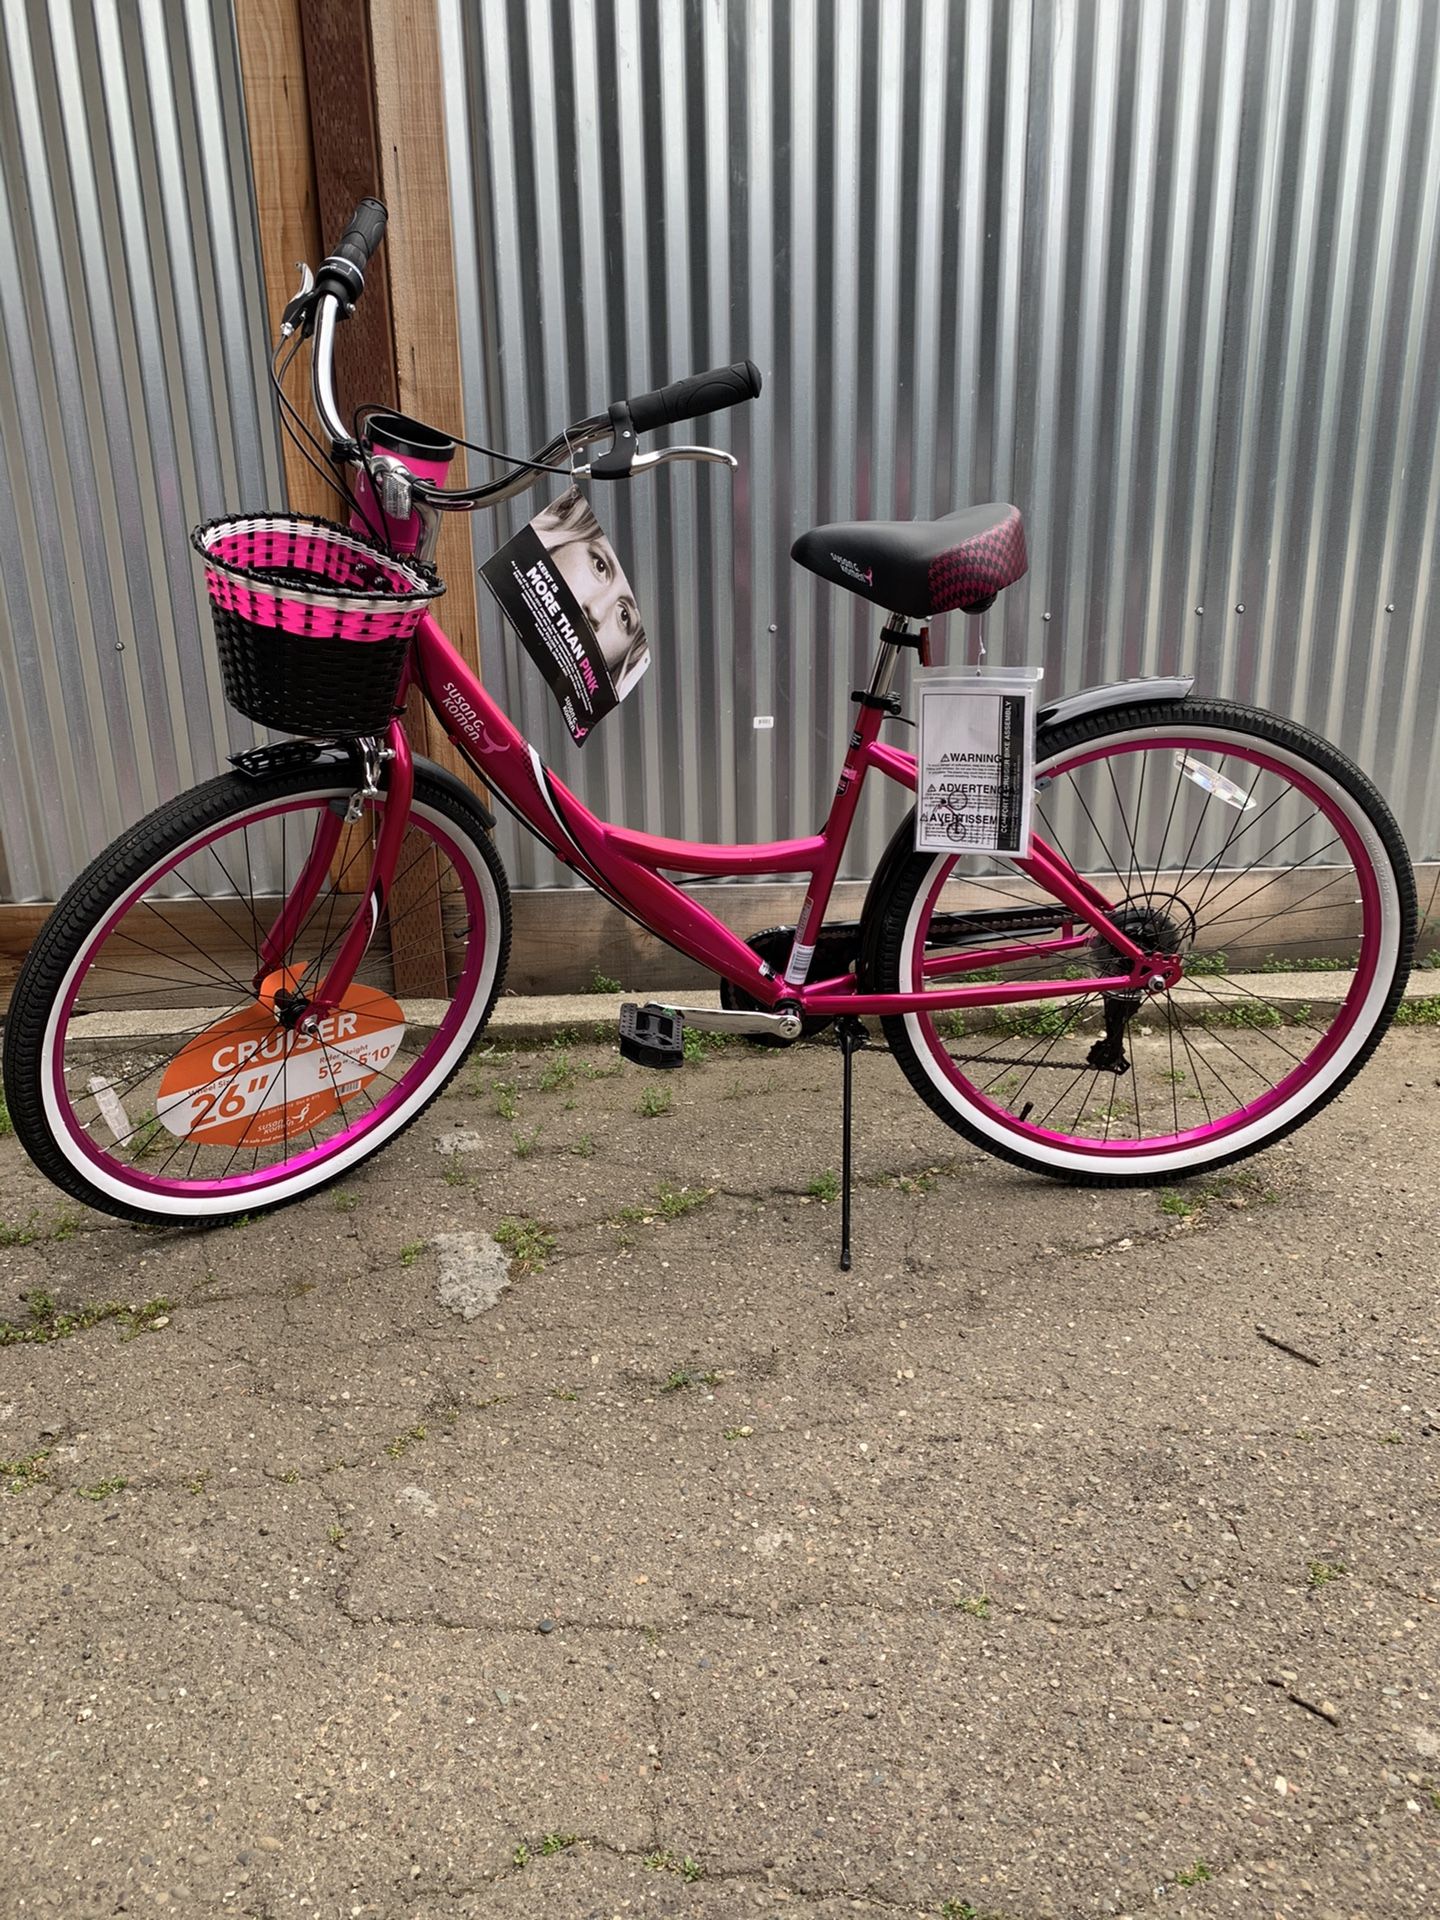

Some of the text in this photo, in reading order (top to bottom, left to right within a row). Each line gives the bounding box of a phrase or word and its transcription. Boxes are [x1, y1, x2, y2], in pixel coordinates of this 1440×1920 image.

[536, 560, 559, 593] KENT IS
[526, 566, 561, 617] MORE
[556, 613, 585, 660] THAN
[579, 657, 599, 695] PINK
[443, 682, 485, 732] susan G.
[950, 752, 1002, 764] WARNING
[939, 783, 1001, 795] ADVERTENC
[930, 812, 998, 825] AVERTISSEM
[212, 1013, 358, 1073] CRUISER
[190, 1075, 269, 1128] 26"
